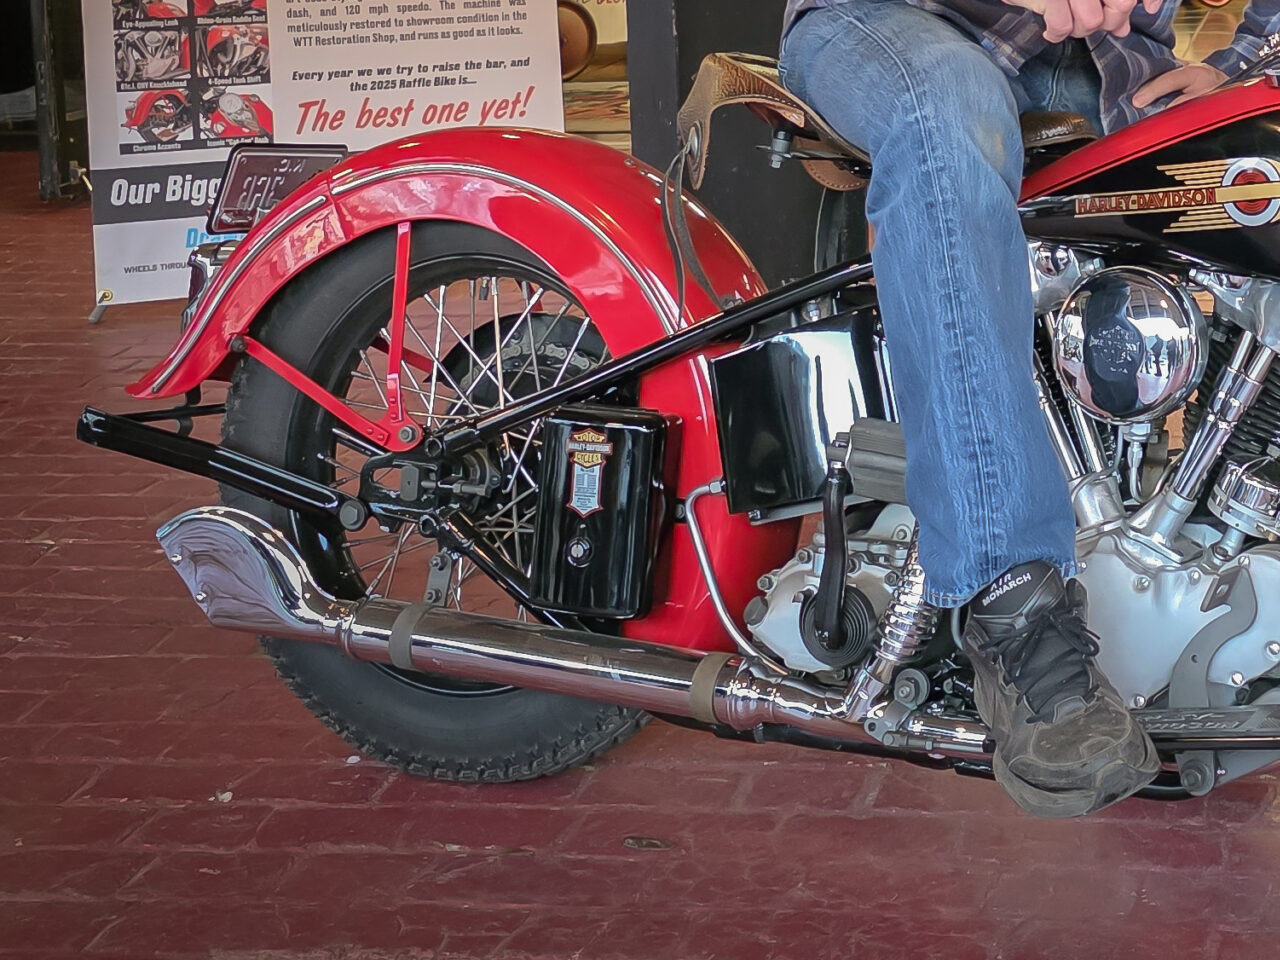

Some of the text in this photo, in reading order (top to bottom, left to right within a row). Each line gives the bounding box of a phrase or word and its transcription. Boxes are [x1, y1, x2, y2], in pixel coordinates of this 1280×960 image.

[287, 7, 312, 19] dash,
[320, 6, 337, 17] and
[345, 5, 360, 15] 120
[369, 3, 388, 15] mph
[397, 1, 432, 15] speedo.
[440, 0, 455, 10] The
[287, 10, 527, 33] meticulously restored to showroom condition in the
[293, 25, 523, 47] WTT Restoration Shop, and runs as good as it looks.
[292, 57, 530, 82] Every year we we try to raise the bar, and
[350, 81, 367, 92] the
[370, 79, 397, 90] 2025
[399, 77, 431, 89] Raffle
[433, 76, 456, 86] Bike
[296, 85, 536, 135] The best one yet!
[110, 178, 160, 206] Our
[1077, 188, 1216, 214] HARLEY-DAVIDSON
[124, 263, 158, 274] WHEELS
[982, 572, 1032, 607] MONARCH
[990, 573, 1012, 592] AIR
